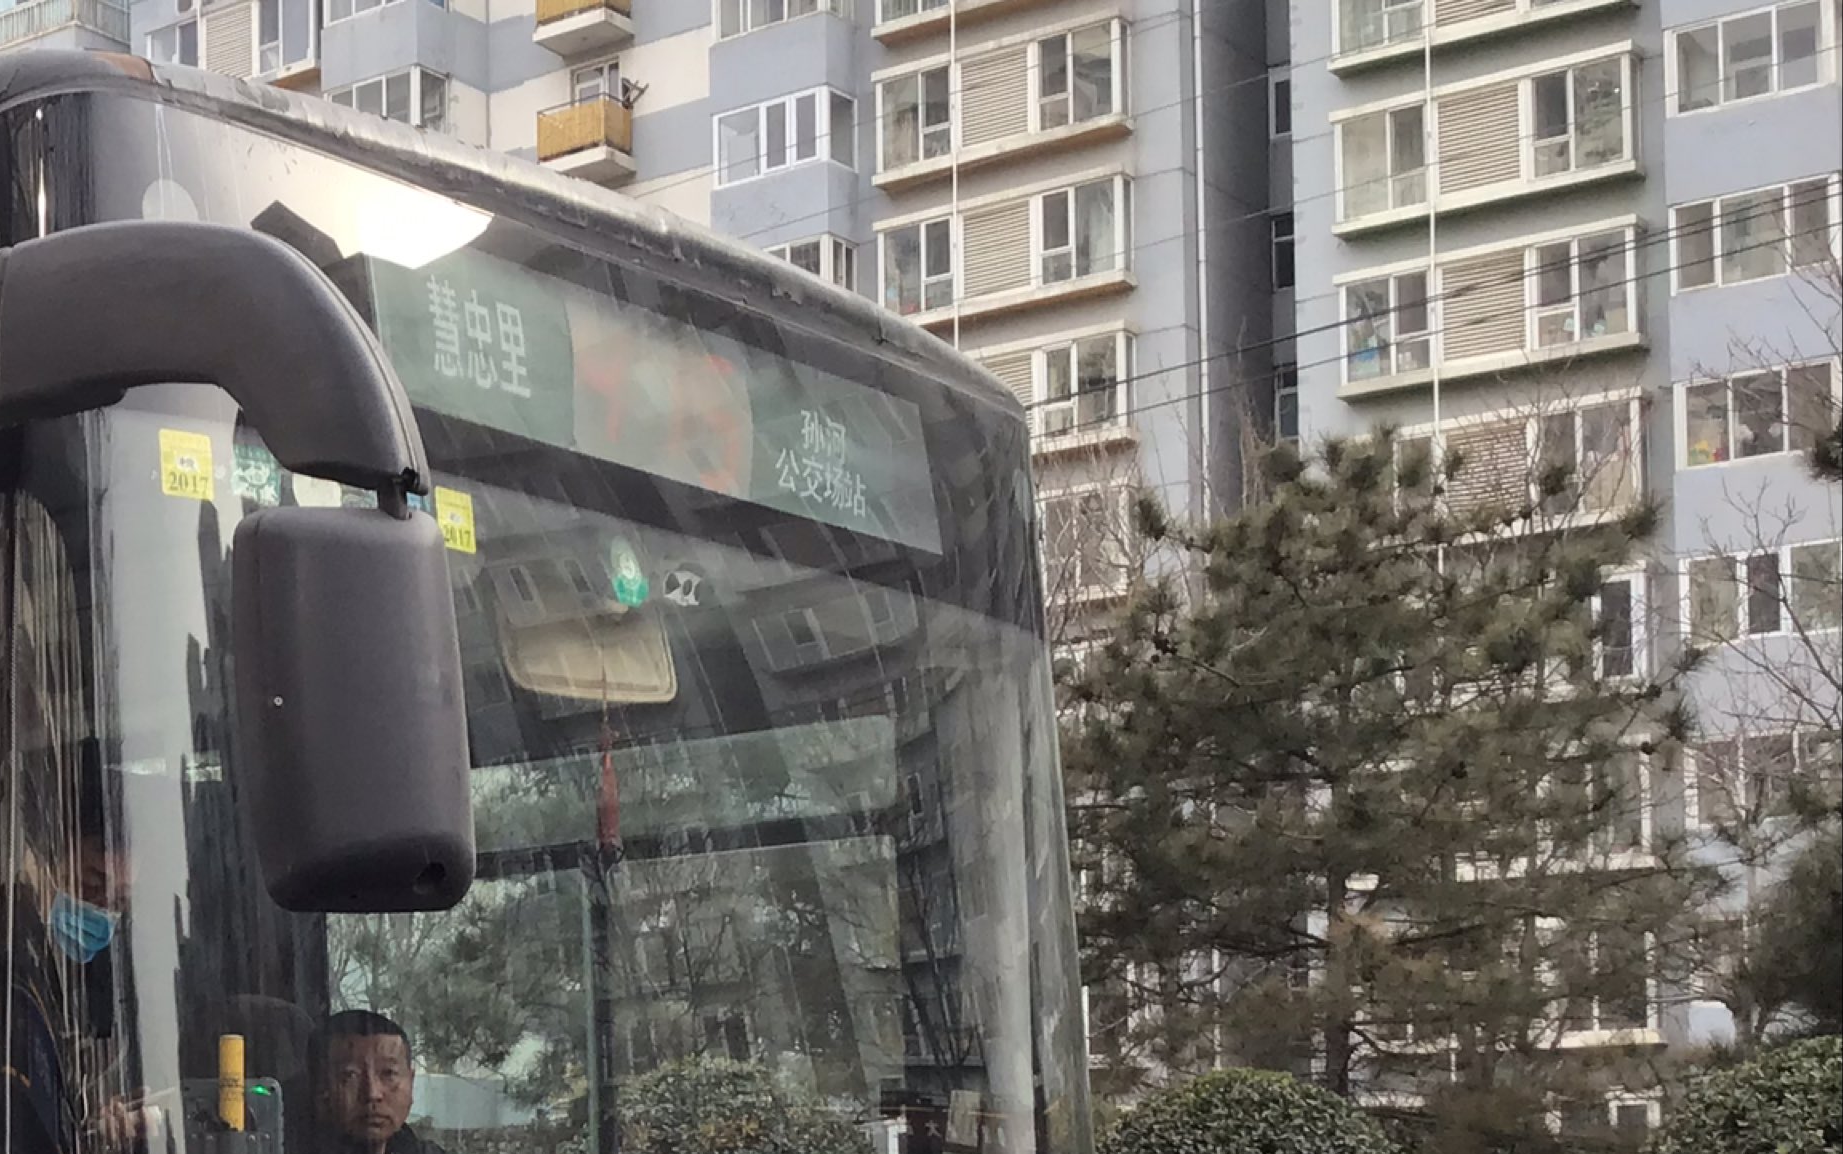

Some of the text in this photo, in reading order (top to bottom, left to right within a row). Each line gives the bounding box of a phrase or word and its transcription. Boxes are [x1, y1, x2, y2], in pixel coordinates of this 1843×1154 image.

[426, 274, 532, 399] 慧忠里
[168, 471, 209, 496] 2017
[774, 446, 869, 519] 公交场站
